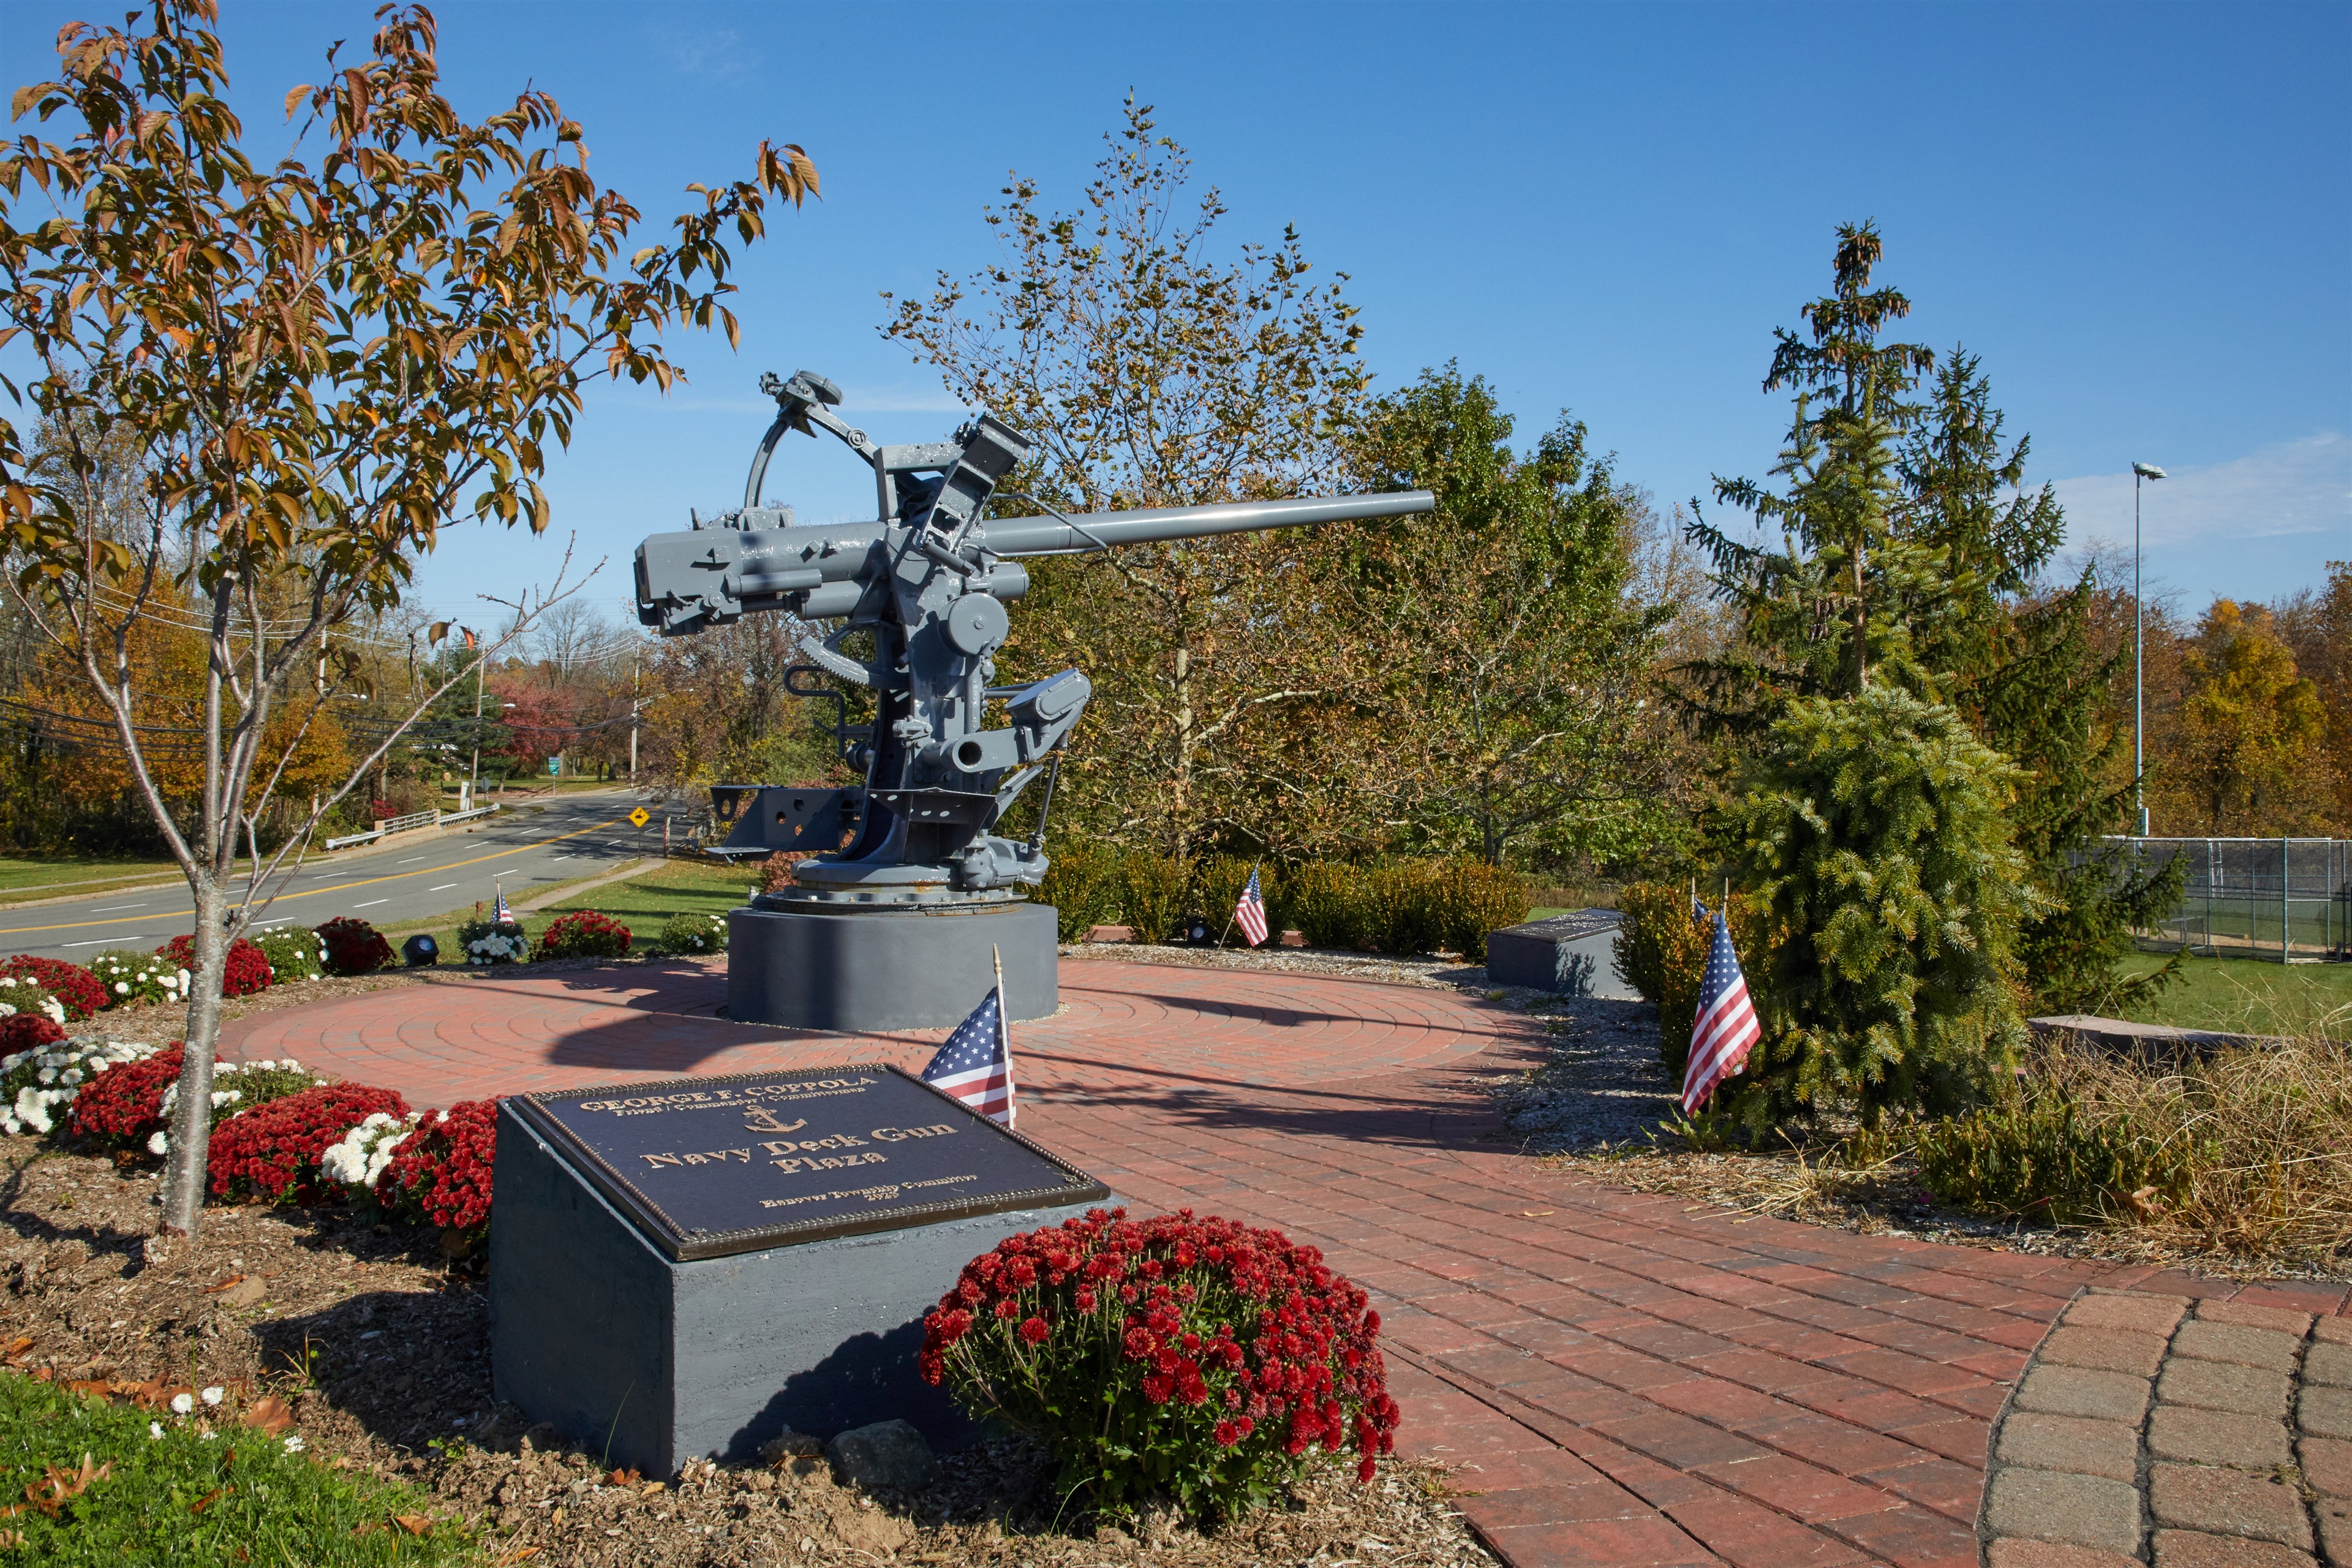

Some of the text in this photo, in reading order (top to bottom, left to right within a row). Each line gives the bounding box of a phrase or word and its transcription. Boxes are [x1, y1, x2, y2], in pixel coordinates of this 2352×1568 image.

[580, 1077, 879, 1111] GEORGE F. COPPOLA
[674, 1098, 758, 1111] Commander
[768, 1087, 866, 1102] Committeeman
[640, 1124, 958, 1169] Navy Deck Gun
[770, 1152, 888, 1174] Plaza
[759, 1174, 978, 1208] Hanover Township Committee
